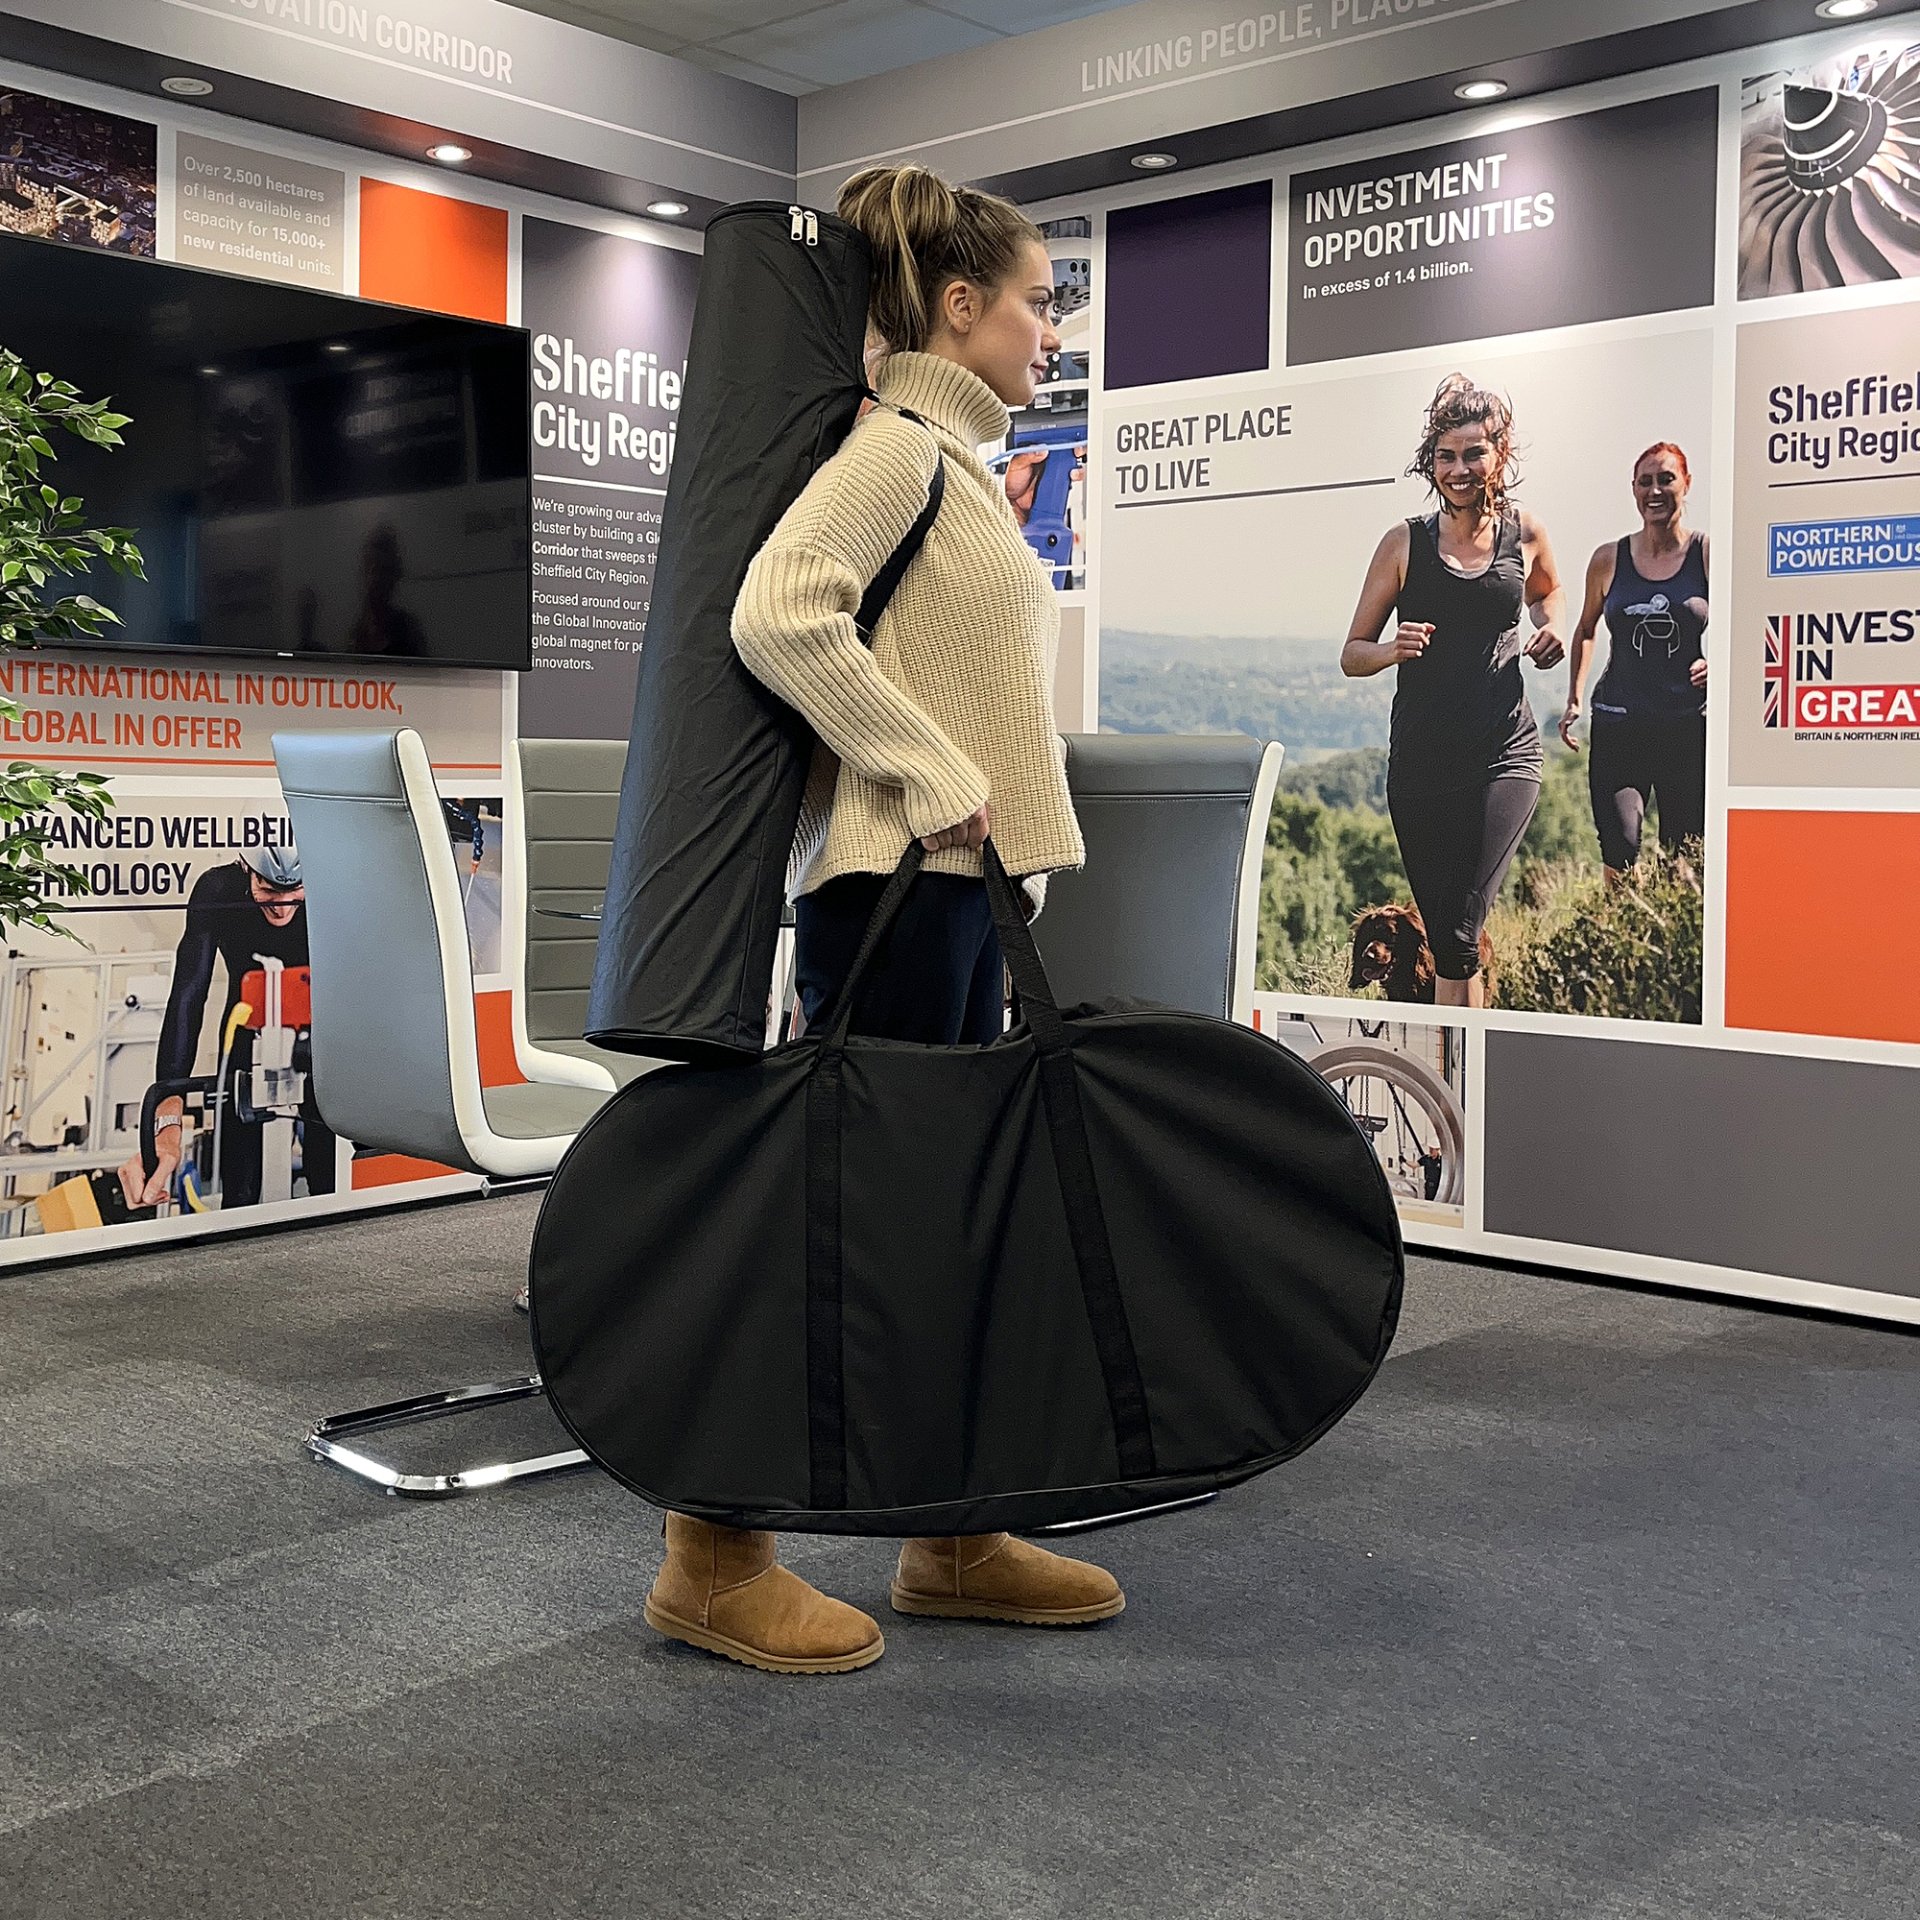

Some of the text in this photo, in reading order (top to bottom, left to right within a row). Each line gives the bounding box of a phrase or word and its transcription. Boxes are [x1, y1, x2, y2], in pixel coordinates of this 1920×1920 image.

[375, 15, 513, 84] CORRIDOR
[1081, 35, 1192, 92] LINKING
[1201, 5, 1321, 62] PEOPLE,
[184, 156, 325, 202] Over 2,500 hectares
[1305, 153, 1507, 224] INVESTMENT
[184, 183, 331, 227] of land available and
[183, 209, 326, 250] capacity for 15,000+
[1304, 192, 1555, 268] OPPORTUNITIES
[183, 234, 335, 276] new residential units.
[1303, 261, 1473, 300] In excess of 1.4 billion.
[533, 333, 688, 411] Sheffie
[533, 401, 677, 476] City Regi
[1116, 405, 1292, 453] GREAT PLACE
[1768, 421, 1920, 469] City Regio
[1116, 457, 1210, 494] TO LIVE
[533, 497, 565, 512] We're
[567, 504, 613, 521] growing
[615, 510, 634, 521] our
[532, 520, 660, 545] cluster by building a Gl
[1776, 524, 1891, 548] NORTHERN
[532, 541, 579, 557] Corridor
[581, 546, 603, 560] that
[605, 550, 646, 565] sweeps
[532, 562, 649, 586] Sheffield City Region.
[532, 590, 579, 606] Focused
[581, 597, 621, 609] around
[622, 601, 642, 611] our
[532, 612, 550, 626] the
[553, 613, 590, 628] Global
[532, 634, 567, 650] global
[569, 639, 611, 652] magnet
[613, 638, 630, 651] for
[1797, 609, 1920, 645] INVES
[532, 655, 595, 671] innovators.
[1796, 649, 1833, 681] IN
[236, 673, 264, 705] IN
[271, 675, 403, 715] OUTLOOK,
[1801, 689, 1920, 723] GREA
[0, 709, 243, 750] LOBAL IN OFFER
[1795, 732, 1832, 741] BRITAIN
[1834, 732, 1841, 741] &
[1843, 732, 1898, 741] NORTHERN
